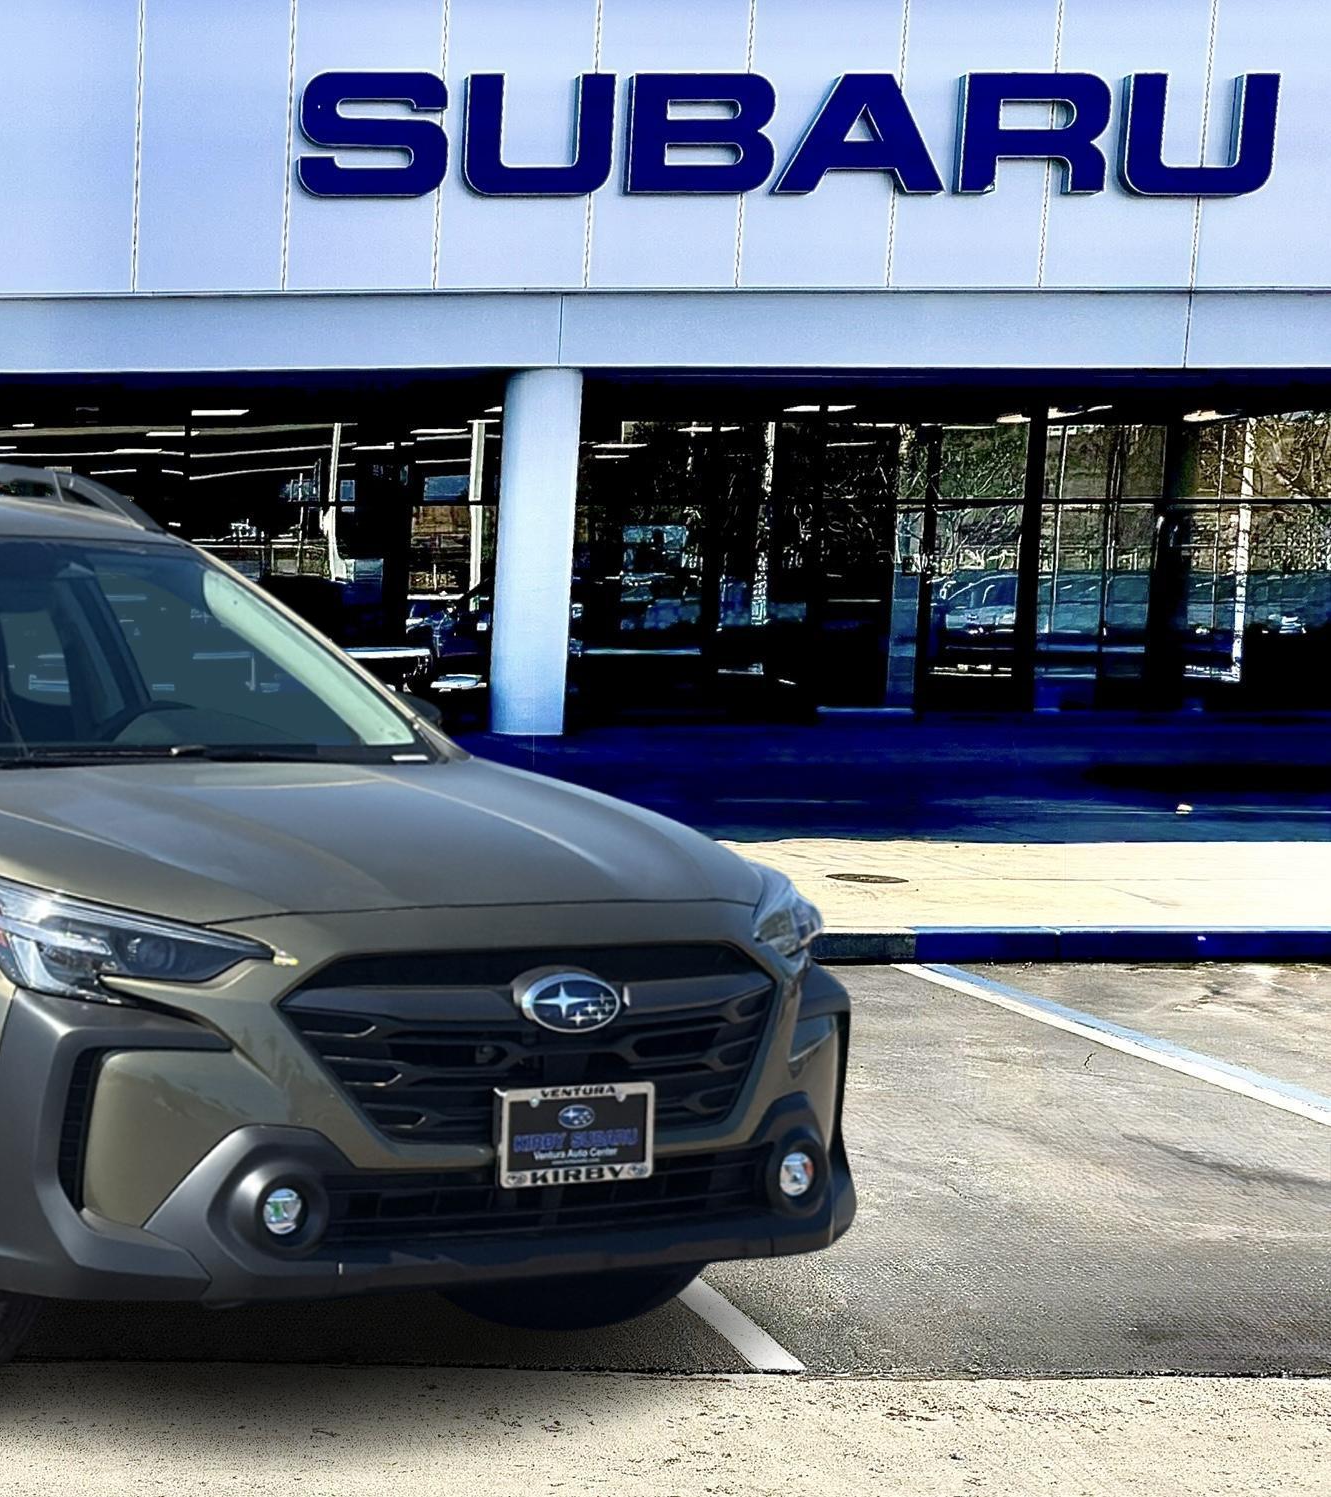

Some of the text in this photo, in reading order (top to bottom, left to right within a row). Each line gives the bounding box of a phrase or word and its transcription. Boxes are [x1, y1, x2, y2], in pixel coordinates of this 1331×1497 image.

[296, 70, 1281, 198] SUBARU
[540, 1085, 616, 1098] VENTURA
[513, 1129, 638, 1152] KIRBY SUBARU
[533, 1147, 618, 1160] Ventura Auto Center
[530, 1165, 624, 1184] KIRBY
